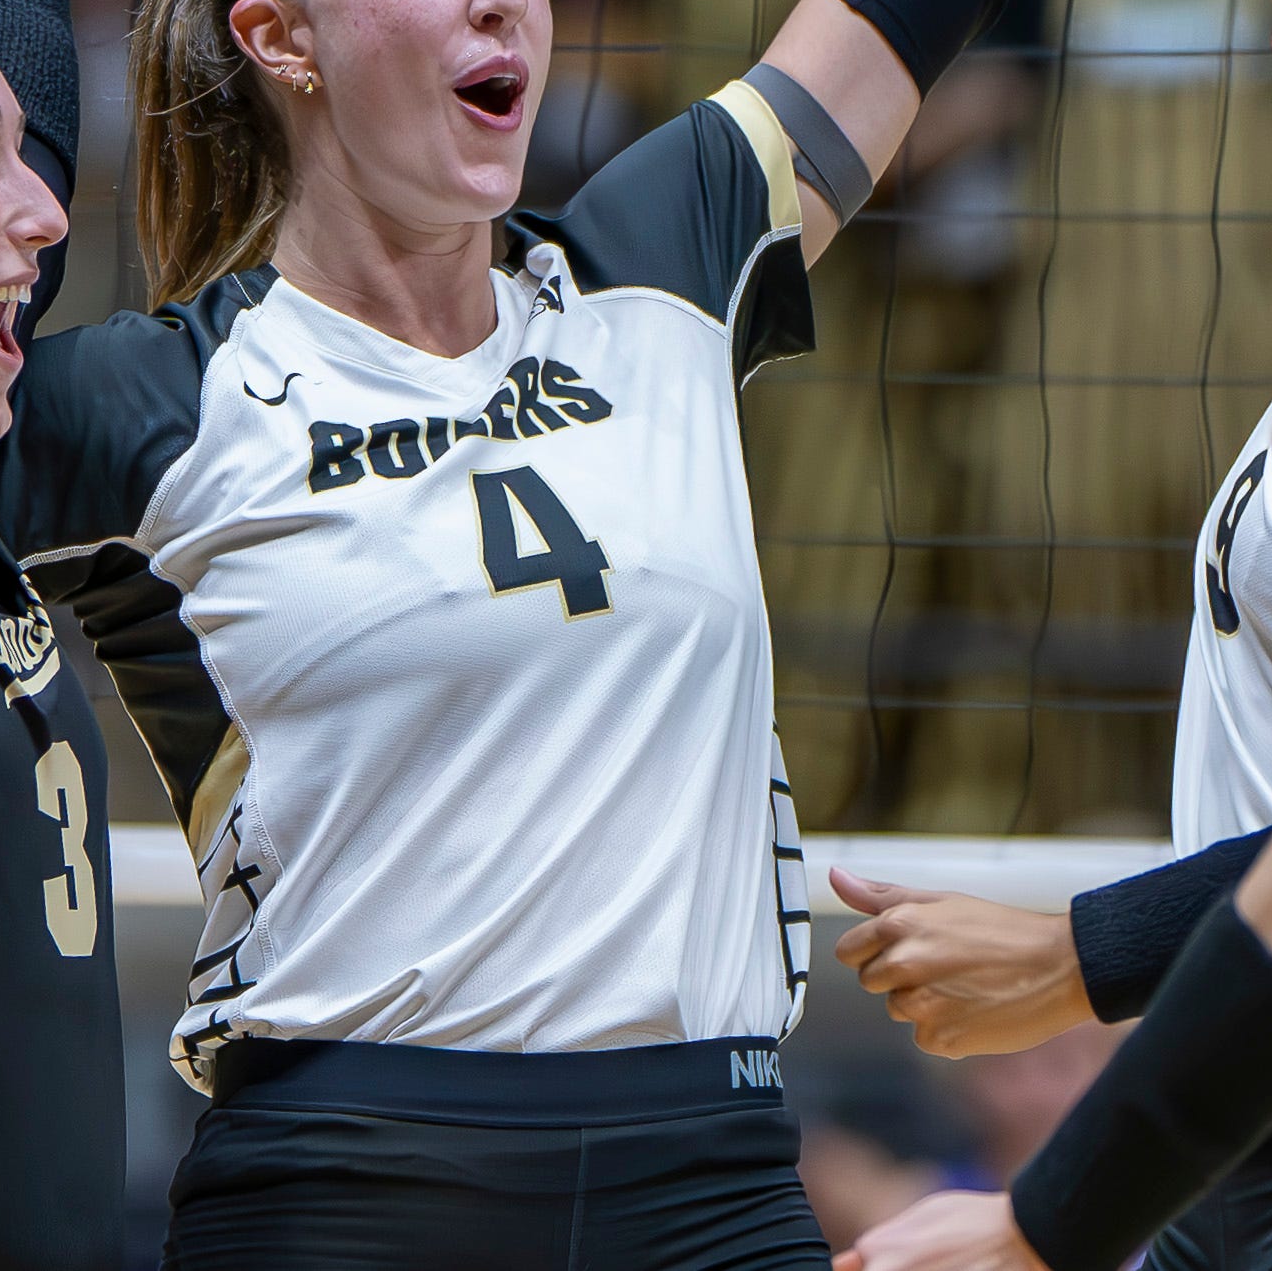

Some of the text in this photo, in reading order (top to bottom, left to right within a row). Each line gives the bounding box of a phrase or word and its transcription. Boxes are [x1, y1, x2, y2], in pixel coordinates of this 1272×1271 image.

[468, 463, 617, 623] 4
[35, 740, 98, 957] 3
[730, 1049, 784, 1089] NIK
